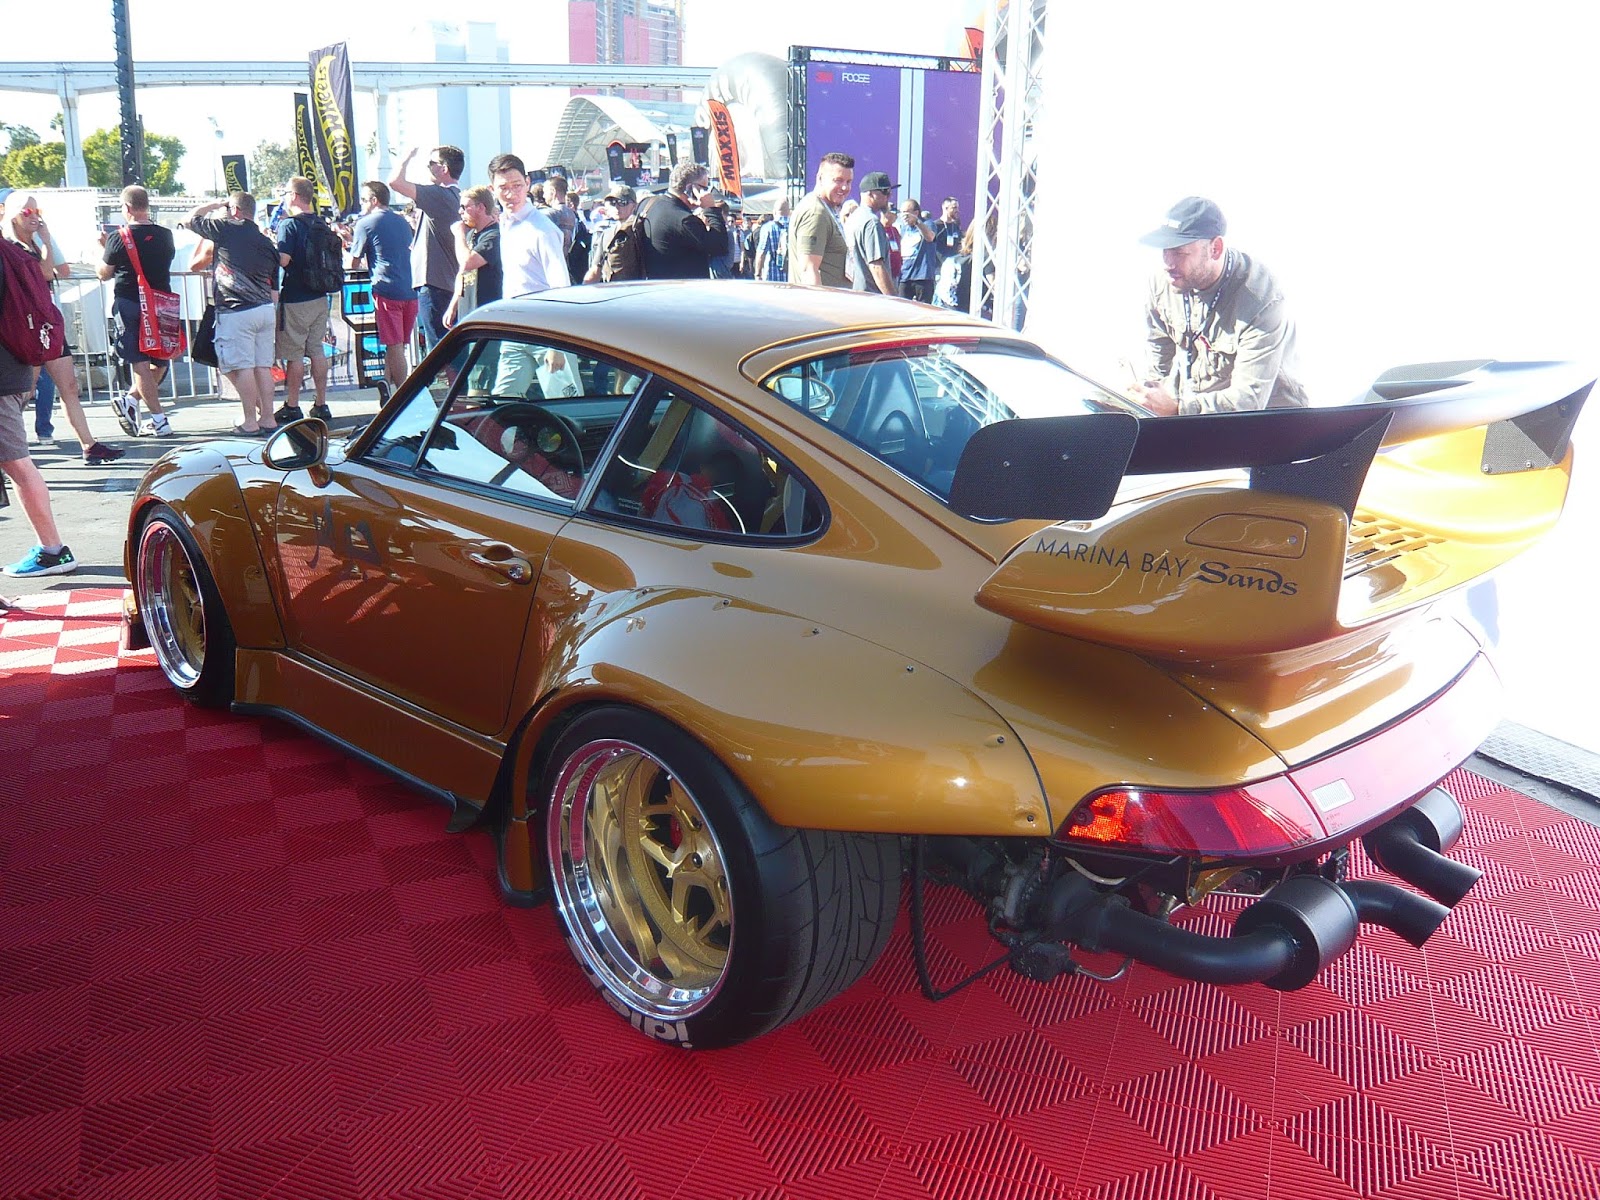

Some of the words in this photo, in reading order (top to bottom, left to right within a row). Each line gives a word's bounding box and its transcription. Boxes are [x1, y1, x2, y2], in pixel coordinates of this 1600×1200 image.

[841, 72, 871, 84] FOOSE
[713, 111, 735, 181] MAXXIS
[138, 285, 152, 336] SPYDER
[1035, 537, 1130, 569] MARINA
[1140, 552, 1190, 578] BAY
[1194, 561, 1299, 597] Sands
